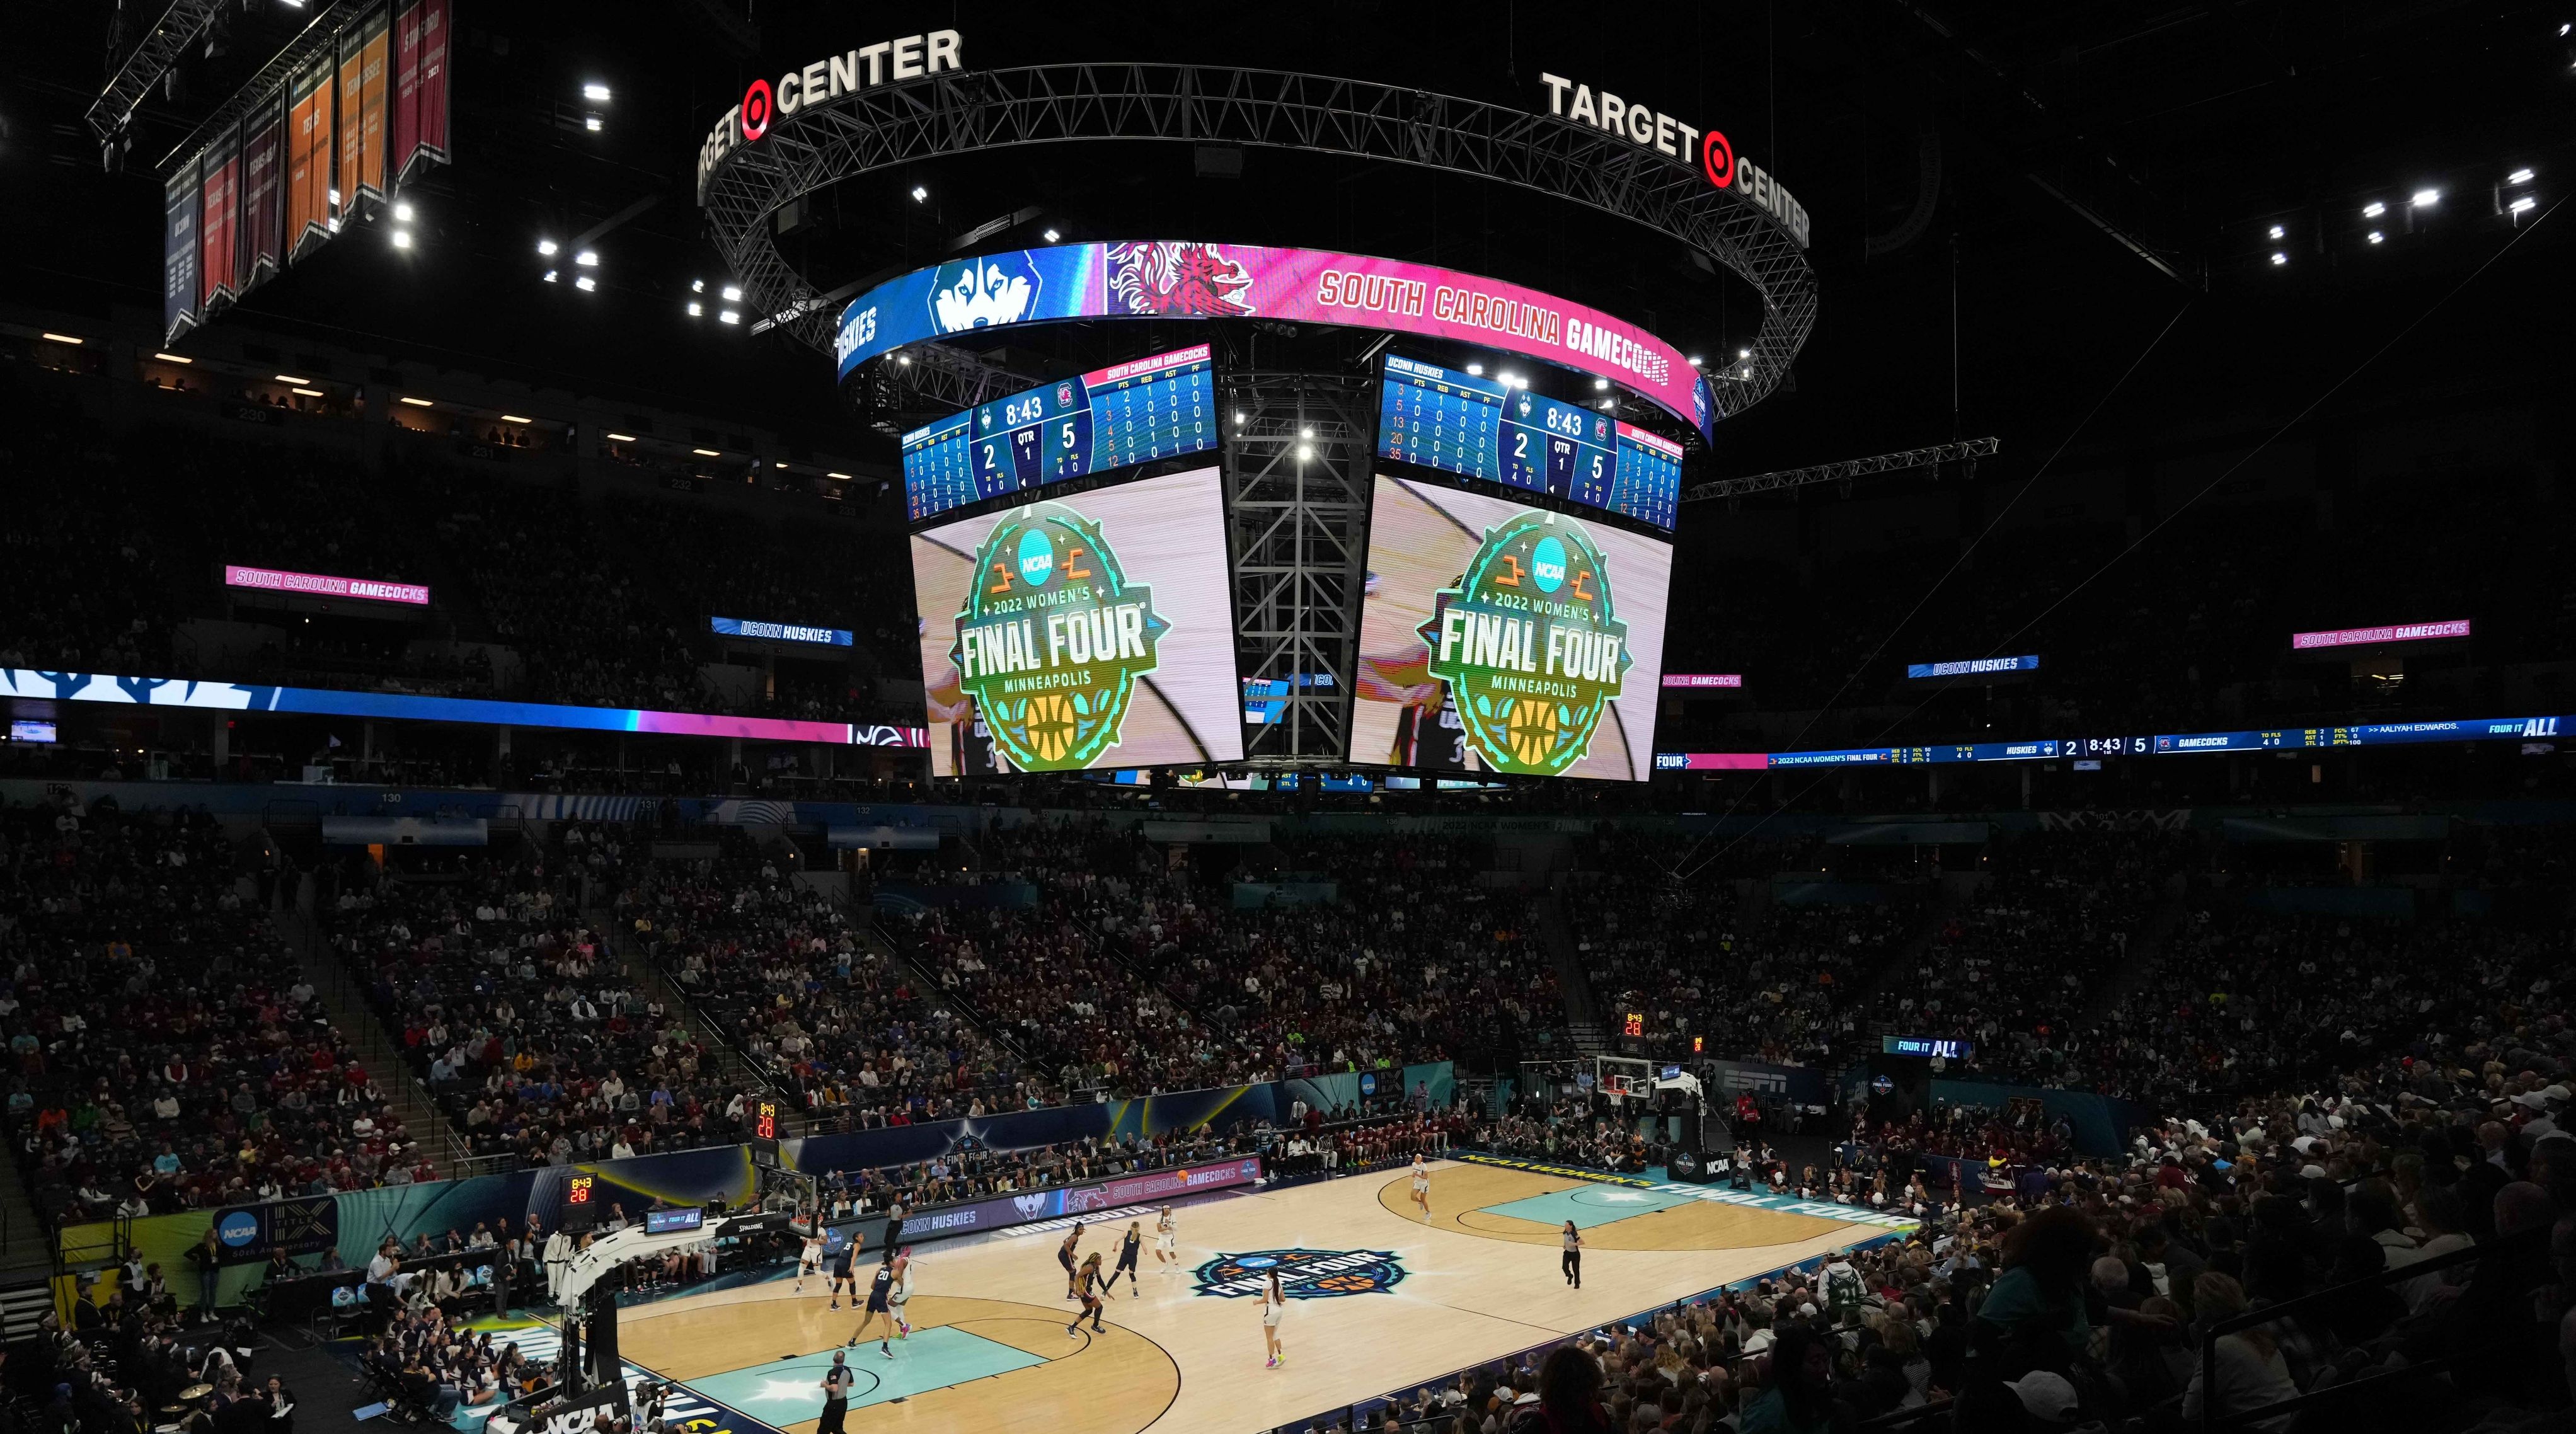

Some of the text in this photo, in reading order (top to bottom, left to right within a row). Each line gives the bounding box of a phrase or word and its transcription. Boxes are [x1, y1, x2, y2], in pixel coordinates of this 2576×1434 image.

[428, 64, 439, 79] 2021
[777, 29, 961, 114] CENTER
[1539, 71, 1810, 249] TARGET CENTER
[1317, 270, 1669, 387] SOUTH CAROLINA GAMECOCKS
[1107, 346, 1209, 380] SOUTH CAROLINA GAMECOCKS
[1388, 357, 1444, 379] UCONN HUSKIES
[1118, 381, 1129, 389] PTS
[1141, 375, 1153, 384] REB
[1165, 369, 1176, 378] AST
[1124, 374, 1199, 403] 2 0 0
[1413, 379, 1425, 387] PTS
[1437, 384, 1449, 393] REB
[1459, 390, 1471, 398] AST
[1398, 383, 1488, 418] 3 2 0 0
[1006, 396, 1042, 425] 8:43
[1125, 406, 1131, 417] 3
[1393, 416, 1404, 428] 13
[1546, 407, 1582, 436] 8:43
[1018, 430, 1035, 446] QTR
[1062, 422, 1075, 449] 5
[1390, 432, 1403, 444] 20
[1025, 447, 1031, 461] 1
[1389, 448, 1401, 459] 35
[1514, 432, 1528, 459] 2
[1554, 440, 1571, 455] QTR
[984, 444, 996, 469] 2
[1108, 455, 1119, 467] 12
[1558, 457, 1564, 471] 1
[1058, 462, 1078, 475] 4 0
[1592, 454, 1604, 479] 5
[1512, 471, 1532, 485] 4 0
[1022, 554, 1053, 574] NCAA
[1534, 560, 1565, 582] NCAA
[235, 569, 426, 602] SOUTH CAROLINA GAMECOCKS
[993, 585, 1090, 616] 2022 WOMEN'S
[1495, 592, 1590, 622] 2022 WOMEN'S
[740, 621, 832, 643] UCONN HUSKIES
[960, 602, 1146, 679] FINAL FOUR
[2301, 621, 2466, 646] SOUTH CAROLINA GAMECOCKS
[1439, 607, 1619, 684] FINAL FOUR
[1933, 657, 2018, 676] UCONN HUSKIES
[1004, 670, 1092, 694] MINNEAPOLIS
[1491, 674, 1577, 699] MINNEAPOLIS
[1691, 676, 1739, 685] GAMECOCKS
[2379, 723, 2459, 733] AALIYAH EDWARDS.
[2488, 718, 2558, 737] FOUR IT ALL
[2006, 745, 2037, 755] HUSKIES
[2065, 738, 2146, 755] 2 8:43 5
[2178, 737, 2228, 748] GAMECOCKS
[1656, 755, 1684, 767] FOUR
[1813, 755, 1846, 763] WOMEN'S
[1862, 753, 1878, 761] FOUR
[381, 793, 401, 803] 130
[640, 800, 657, 810] 131
[856, 806, 871, 815] 132
[1628, 1013, 1643, 1022] 8:43
[1625, 1021, 1640, 1035] 28
[1897, 1040, 1957, 1058] FOUR IT ALL
[1723, 1069, 1787, 1094] ESPN
[760, 1103, 775, 1117] 8:43
[757, 1115, 773, 1139] 28
[1458, 1154, 1658, 1187] NCAA WOMEN'S
[1706, 1158, 1730, 1175] NCAA
[572, 1177, 592, 1190] 8:43
[1112, 1167, 1236, 1199] SOUTH CAROLINA GAMECOCKS
[570, 1188, 587, 1203] 28
[1645, 1183, 1923, 1227] FINAL FOUR
[275, 1216, 314, 1228] TITLE
[669, 1215, 682, 1224] FOUR
[685, 1212, 699, 1224] ALL
[739, 1222, 763, 1232] SPALDING
[900, 1210, 977, 1236] CONN HUSKIES
[1003, 1205, 1155, 1237] MINNESOTA
[224, 1226, 257, 1239] NCAA
[231, 1248, 256, 1258] 50th
[1277, 1257, 1321, 1270] OMEN'S
[1294, 1251, 1388, 1275] FOUR
[877, 1269, 890, 1281] 20
[1283, 1267, 1360, 1289] MINNEAPOLIS
[1839, 1286, 1857, 1305] 21
